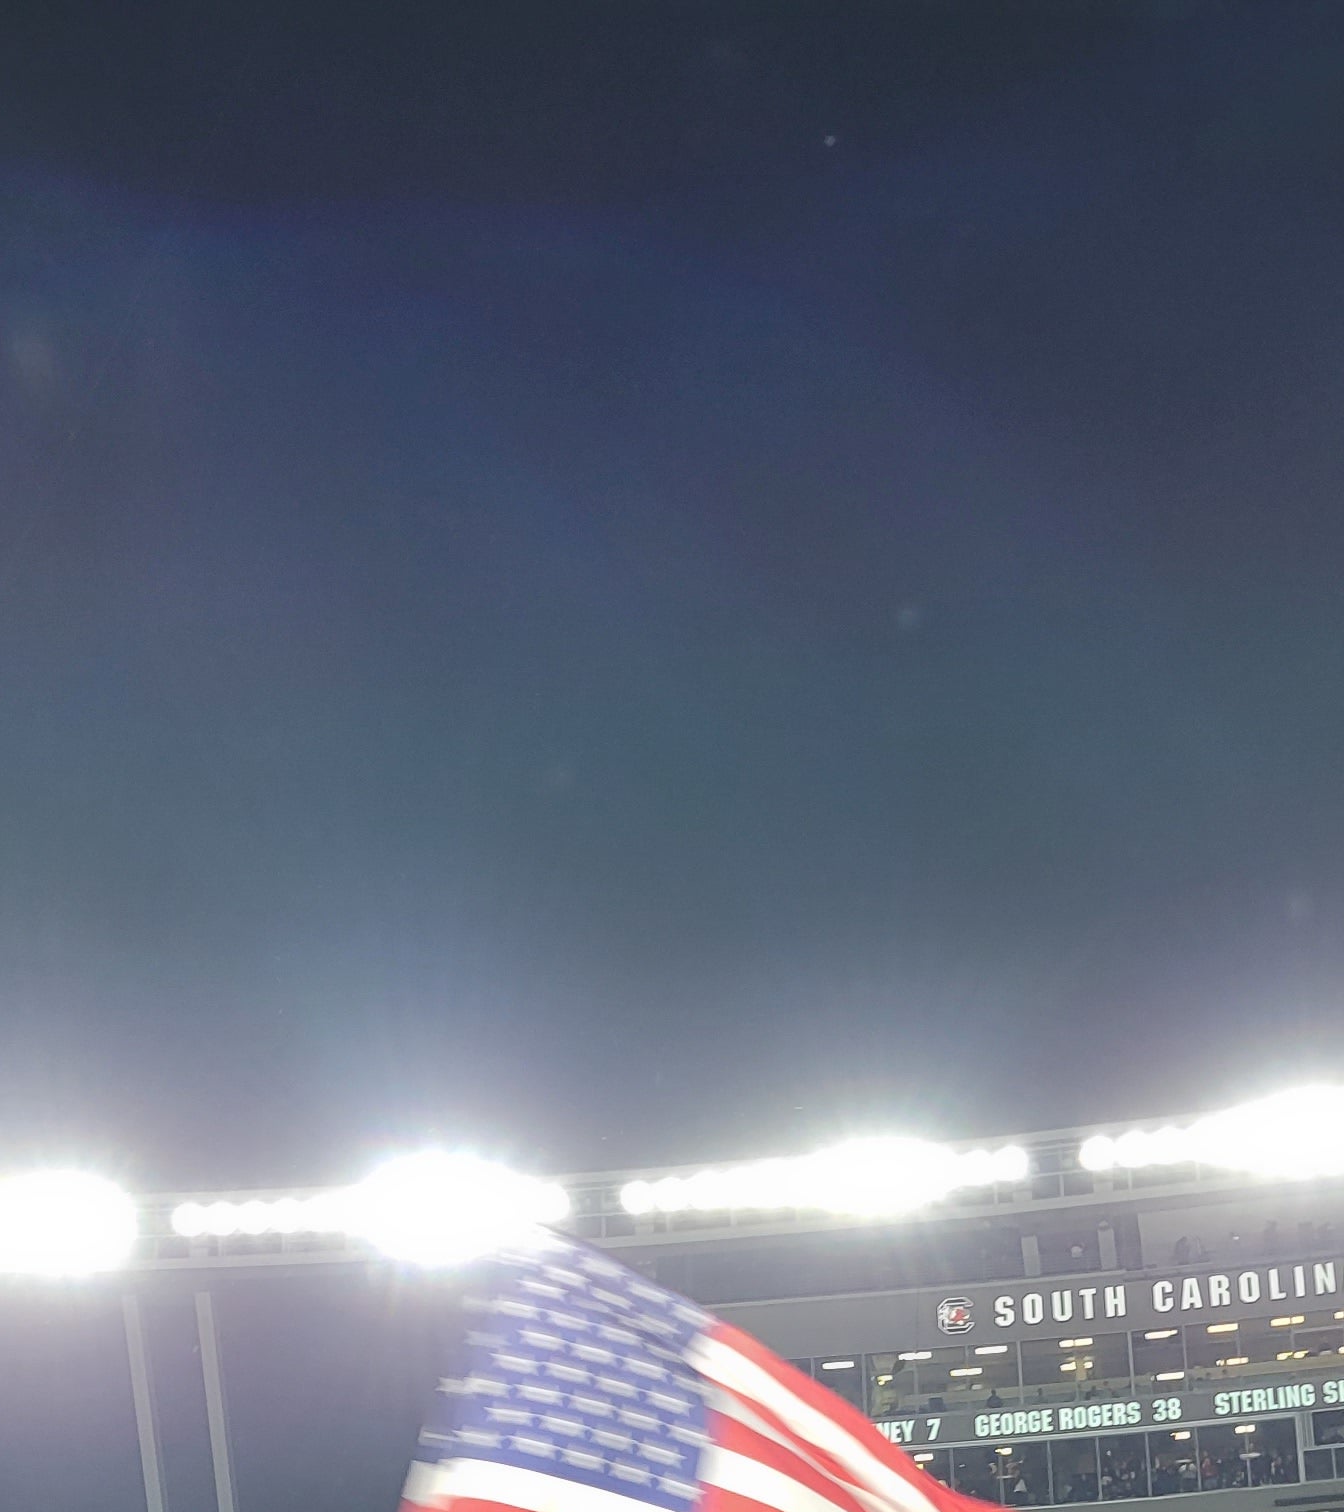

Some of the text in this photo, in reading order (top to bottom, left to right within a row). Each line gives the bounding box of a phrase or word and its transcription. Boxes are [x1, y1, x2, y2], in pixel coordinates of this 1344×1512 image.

[993, 1286, 1127, 1328] SOUTH
[974, 1397, 1182, 1438] GEORGE ROGERS 38
[1214, 1383, 1316, 1416] STERLING
[926, 1418, 942, 1441] 7
